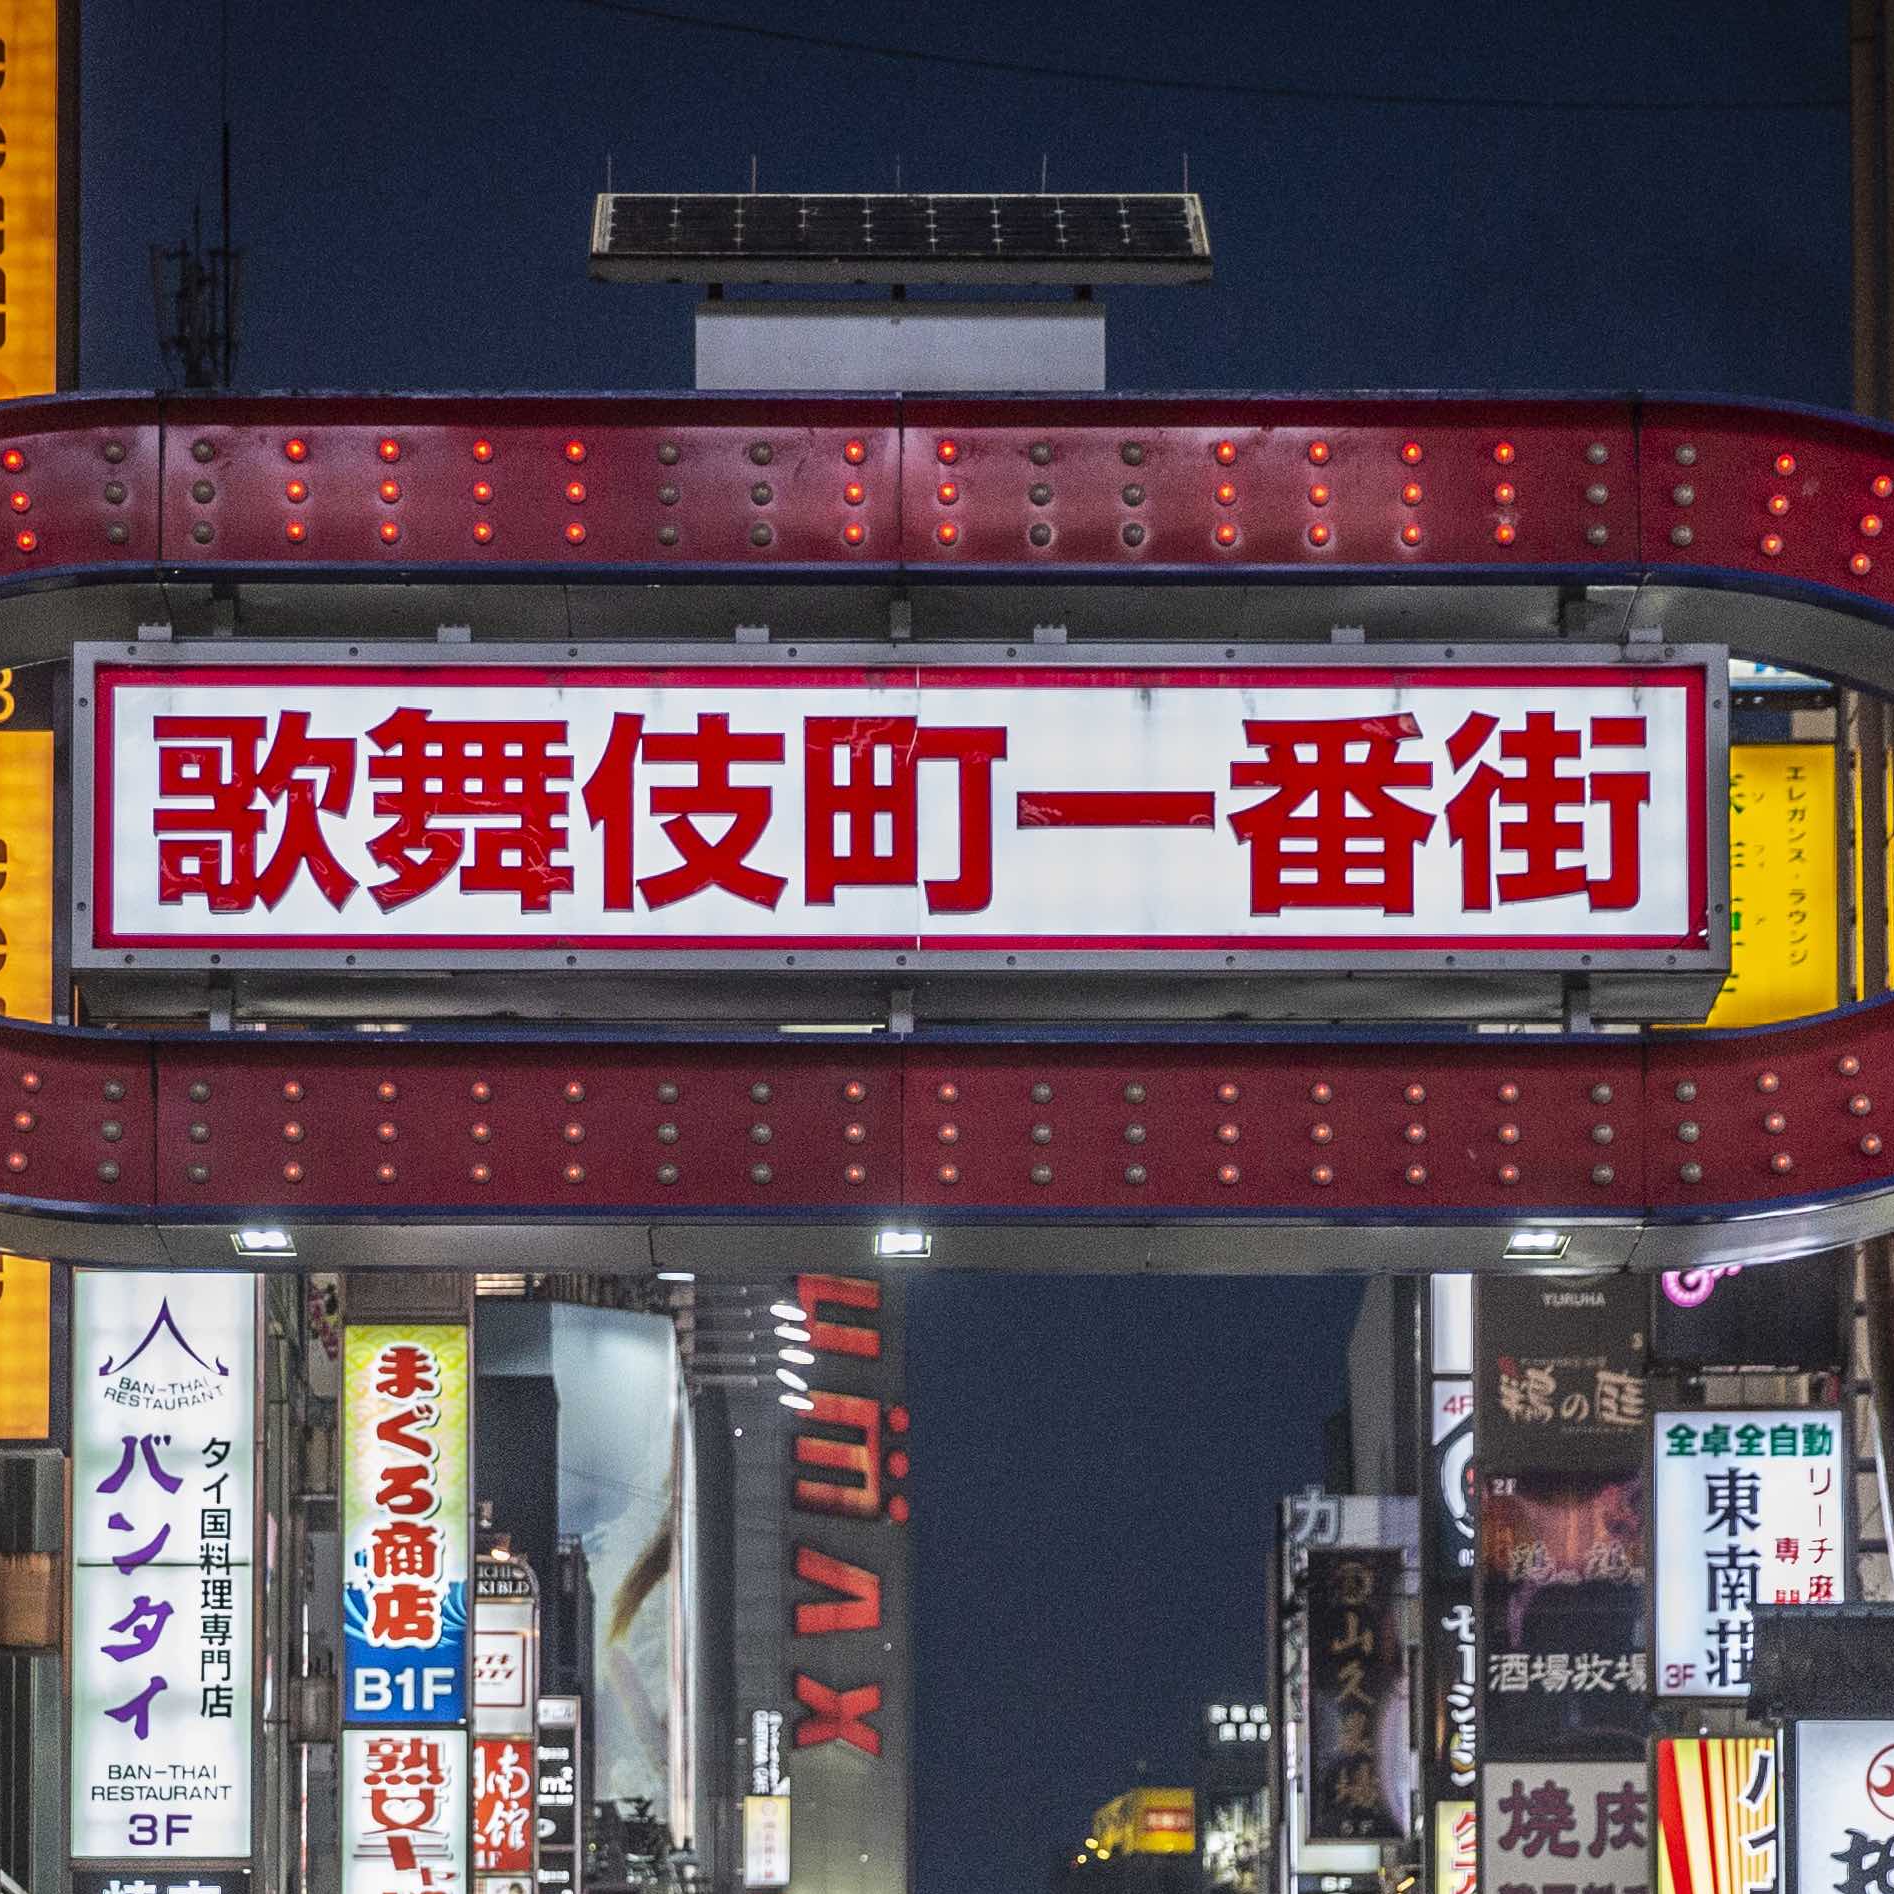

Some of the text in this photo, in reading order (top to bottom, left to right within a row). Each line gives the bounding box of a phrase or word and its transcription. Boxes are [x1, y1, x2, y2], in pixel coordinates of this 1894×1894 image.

[150, 706, 1656, 916] 歌舞伎町一番街
[1666, 1422, 1833, 1457] 全卓全自動
[373, 1345, 442, 1642] まぐろ商店
[96, 1432, 182, 1742] バンタイ
[198, 1436, 234, 1720] タイ国料理専門店
[1705, 1467, 1761, 1687] 東南荘
[355, 1669, 454, 1711] B1F
[1489, 1652, 1647, 1692] 酒場牧場
[1665, 1664, 1696, 1688] 3F
[91, 1784, 232, 1802] RESTAURANT
[107, 1764, 218, 1781] BAN-THAI
[128, 1813, 194, 1847] 3F
